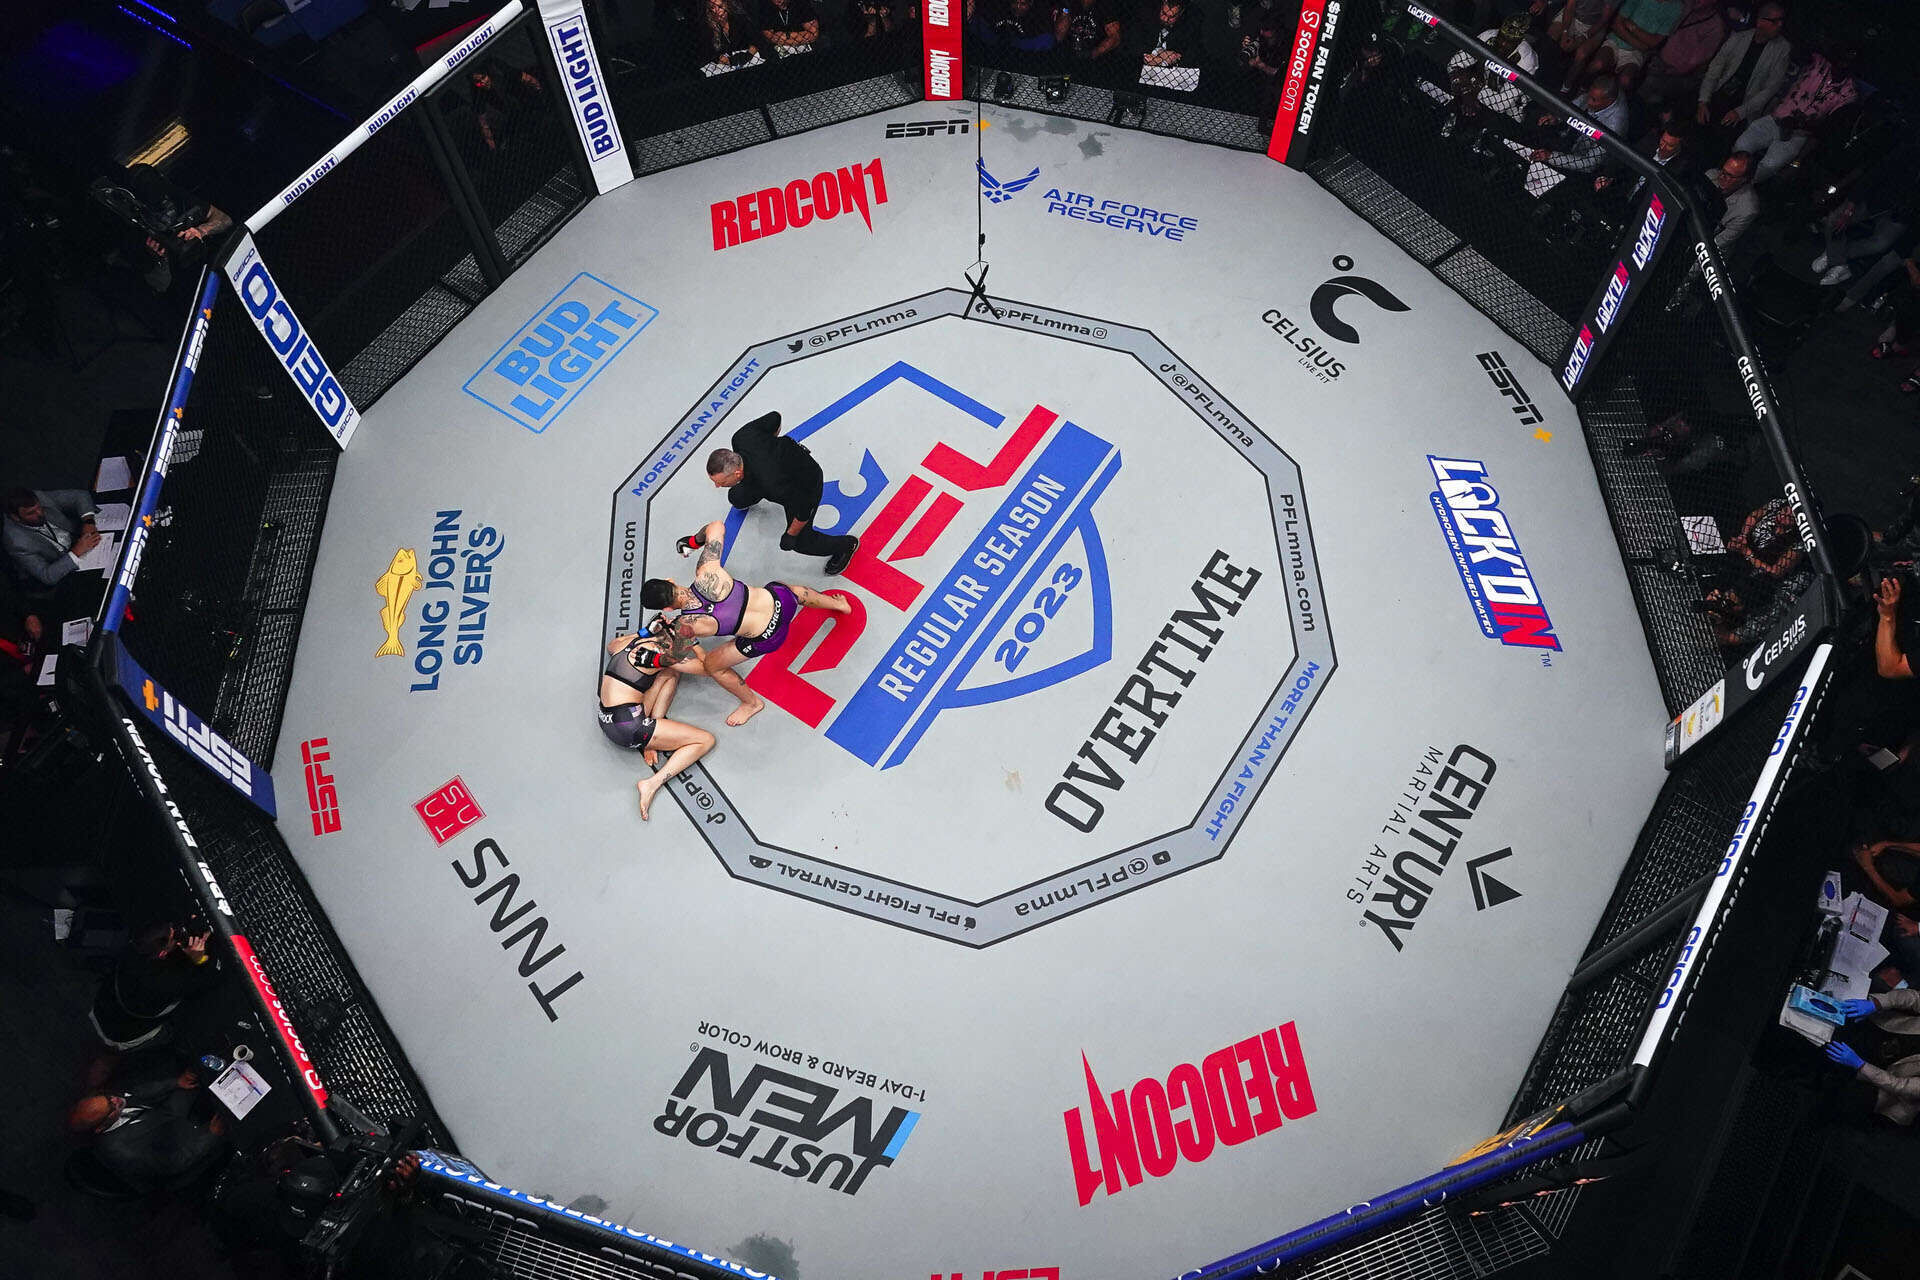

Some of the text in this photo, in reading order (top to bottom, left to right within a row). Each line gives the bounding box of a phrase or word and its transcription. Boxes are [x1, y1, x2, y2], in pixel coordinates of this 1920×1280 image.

[447, 25, 495, 69] BUD LIGHT
[930, 48, 958, 98] REDCON1
[1311, 46, 1329, 80] FAN
[367, 89, 416, 135] BUD LIGHT
[557, 26, 614, 155] BUD LIGHT
[1298, 84, 1320, 135] TOKEN
[284, 157, 337, 205] BUD LIGHT
[710, 157, 889, 252] REDCON1
[1042, 188, 1199, 231] AIR FORCE
[1047, 201, 1186, 242] RESERVE
[232, 248, 255, 282] GEICO
[1694, 242, 1723, 301] CELSIUS
[241, 262, 347, 428] GEICO
[494, 300, 591, 387] BUD
[510, 299, 639, 421] LIGHT
[808, 307, 918, 347] @PFLmma
[993, 306, 1091, 337] @PFLmma
[1261, 308, 1346, 378] CELSIUS
[1298, 357, 1332, 384] LIVE FIT
[1737, 356, 1767, 421] CELSIUS
[336, 408, 354, 439] GEICO
[632, 358, 760, 497] MORE THAN A FIGHT
[1171, 373, 1254, 448] @PFLmma
[1783, 482, 1817, 553] CELSIUS
[409, 509, 462, 693] LONG JOHN
[453, 525, 505, 666] SILVER'S
[745, 404, 1060, 729] PFL
[878, 474, 1066, 702] REGULAR SEASON
[1280, 493, 1316, 632] PFLmma.com
[1432, 496, 1494, 635] HYDROGEN INFUSED WATER
[762, 599, 782, 640] PACHECO
[995, 562, 1084, 673] 2023
[1764, 614, 1807, 666] CELSIUS
[1044, 549, 1263, 834] OVERTIME
[1770, 685, 1807, 757] GEICO
[300, 737, 342, 836] ESPN
[1205, 661, 1321, 841] MORE THAN A FIGHT
[1346, 745, 1444, 904] MARTIAL ARTS
[1363, 744, 1497, 953] CENTURY
[1717, 800, 1757, 877] GEICO
[777, 862, 960, 927] PFL FIGHT CENTRAL
[1015, 857, 1149, 917] @PFLmma
[451, 837, 585, 1023] TNNS
[1656, 926, 1701, 1010] GEICO
[698, 1021, 926, 1102] 1-DAY BEARD & BROW COLOR
[670, 1046, 922, 1159] MEN
[1063, 1020, 1318, 1208] REDCON1
[653, 1099, 895, 1196] JUST FOR
